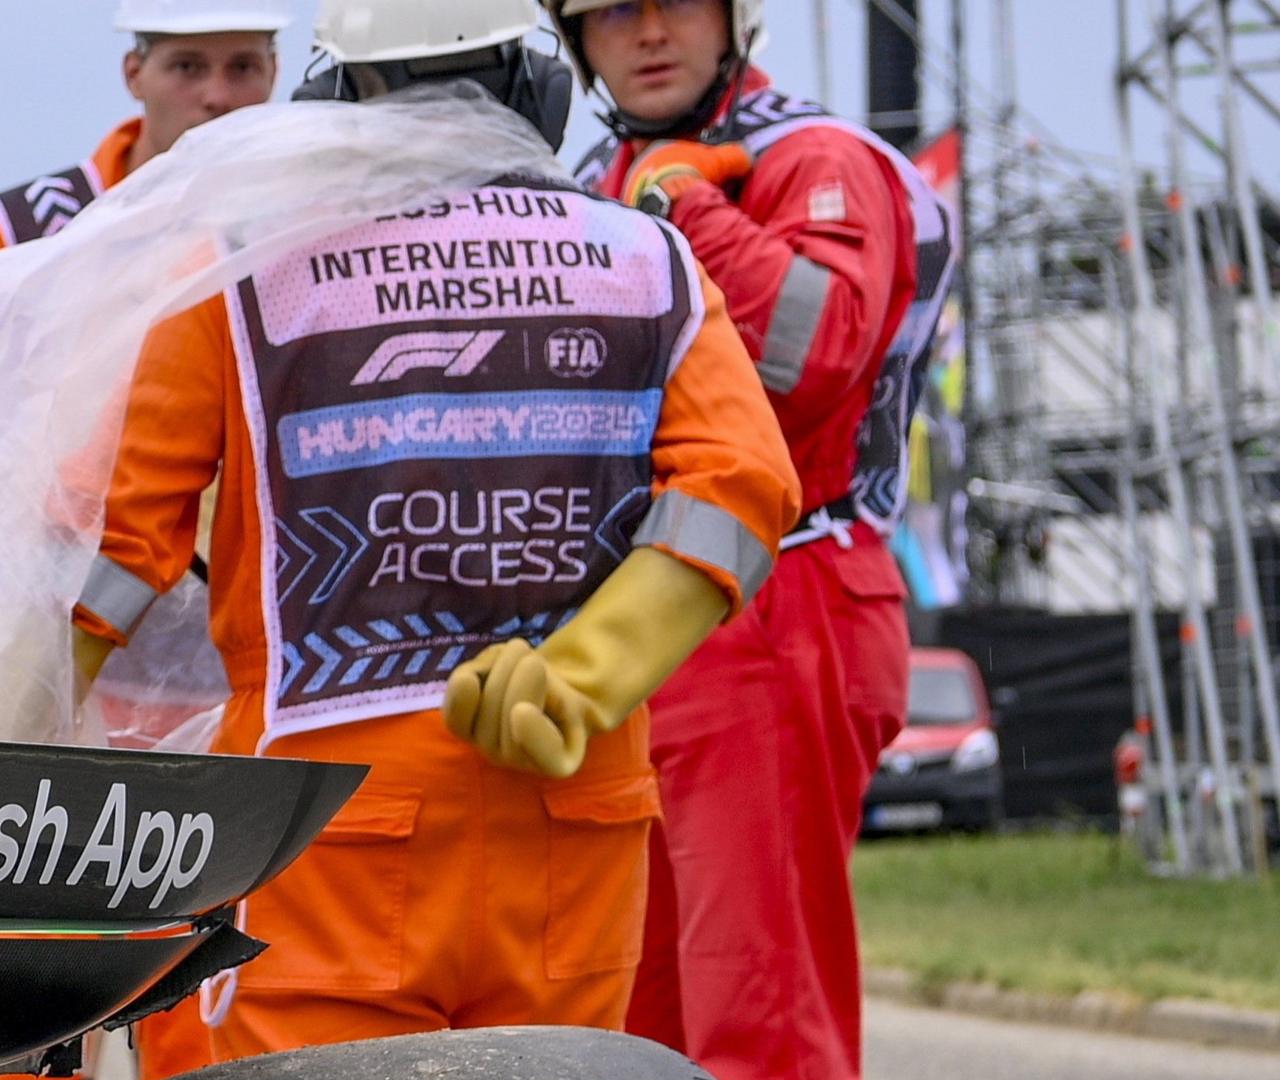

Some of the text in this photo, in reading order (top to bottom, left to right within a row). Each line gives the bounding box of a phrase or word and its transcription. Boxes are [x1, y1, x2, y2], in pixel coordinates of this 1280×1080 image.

[310, 239, 612, 284] INTERVENTION
[375, 275, 575, 314] MARSHAL
[296, 405, 530, 460] HUNGARY
[367, 486, 591, 538] COURSE
[367, 538, 588, 588] ACCESS
[66, 782, 215, 909] App
